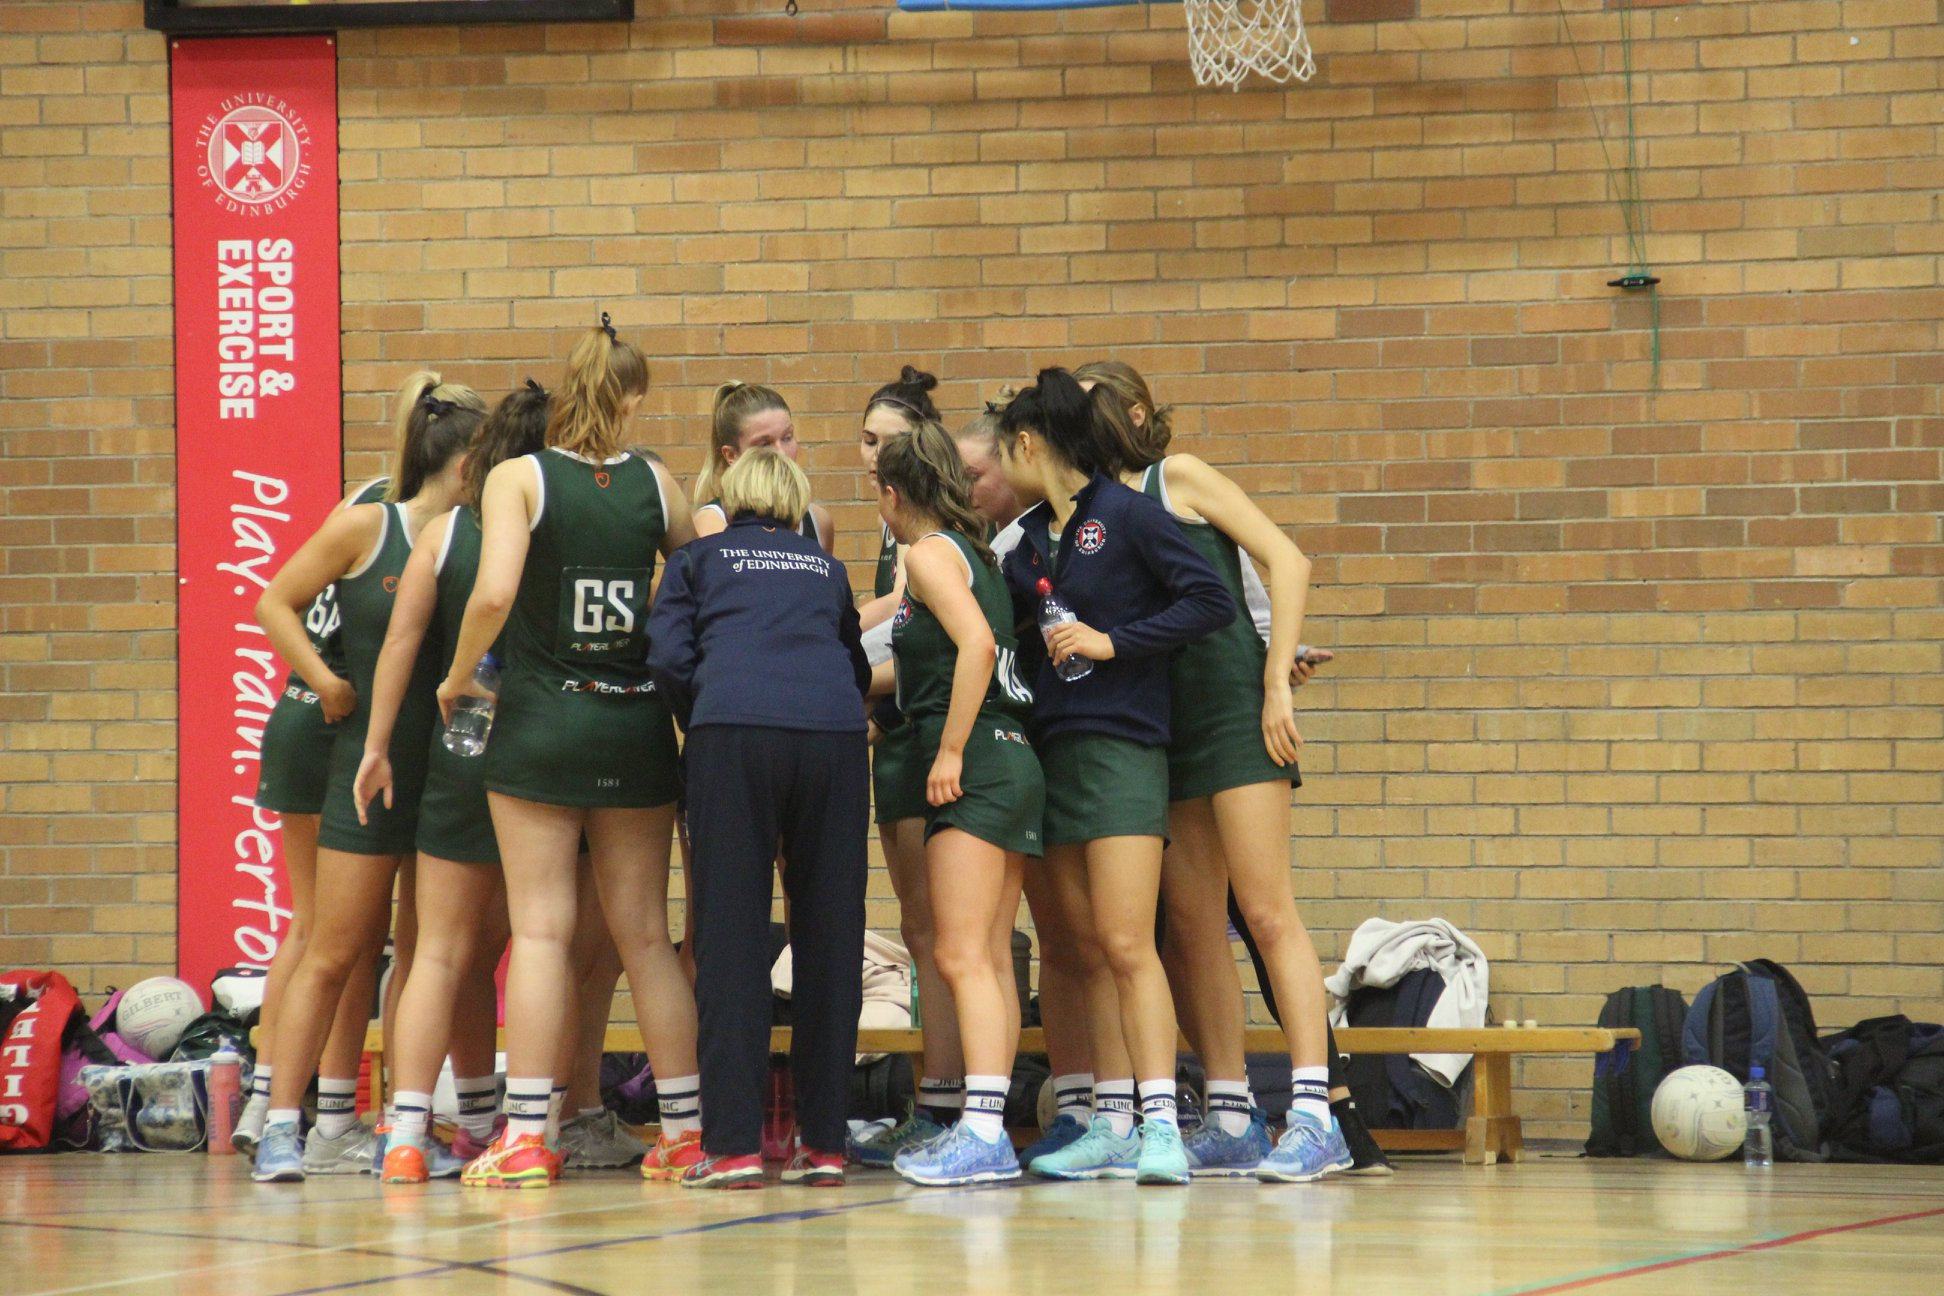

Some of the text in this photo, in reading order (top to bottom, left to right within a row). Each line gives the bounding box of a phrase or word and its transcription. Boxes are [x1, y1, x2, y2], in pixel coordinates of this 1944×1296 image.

[196, 92, 312, 148] THE UNIVERSITY
[196, 163, 312, 217] OF EDINBURGH
[217, 239, 255, 419] EXERCISE
[257, 238, 295, 398] SPORT &
[216, 469, 291, 596] Play.
[719, 548, 830, 569] THE UNIVERSITY
[732, 559, 829, 577] of EDINBURGH
[573, 578, 635, 633] GS
[122, 991, 182, 1021] GILBERT
